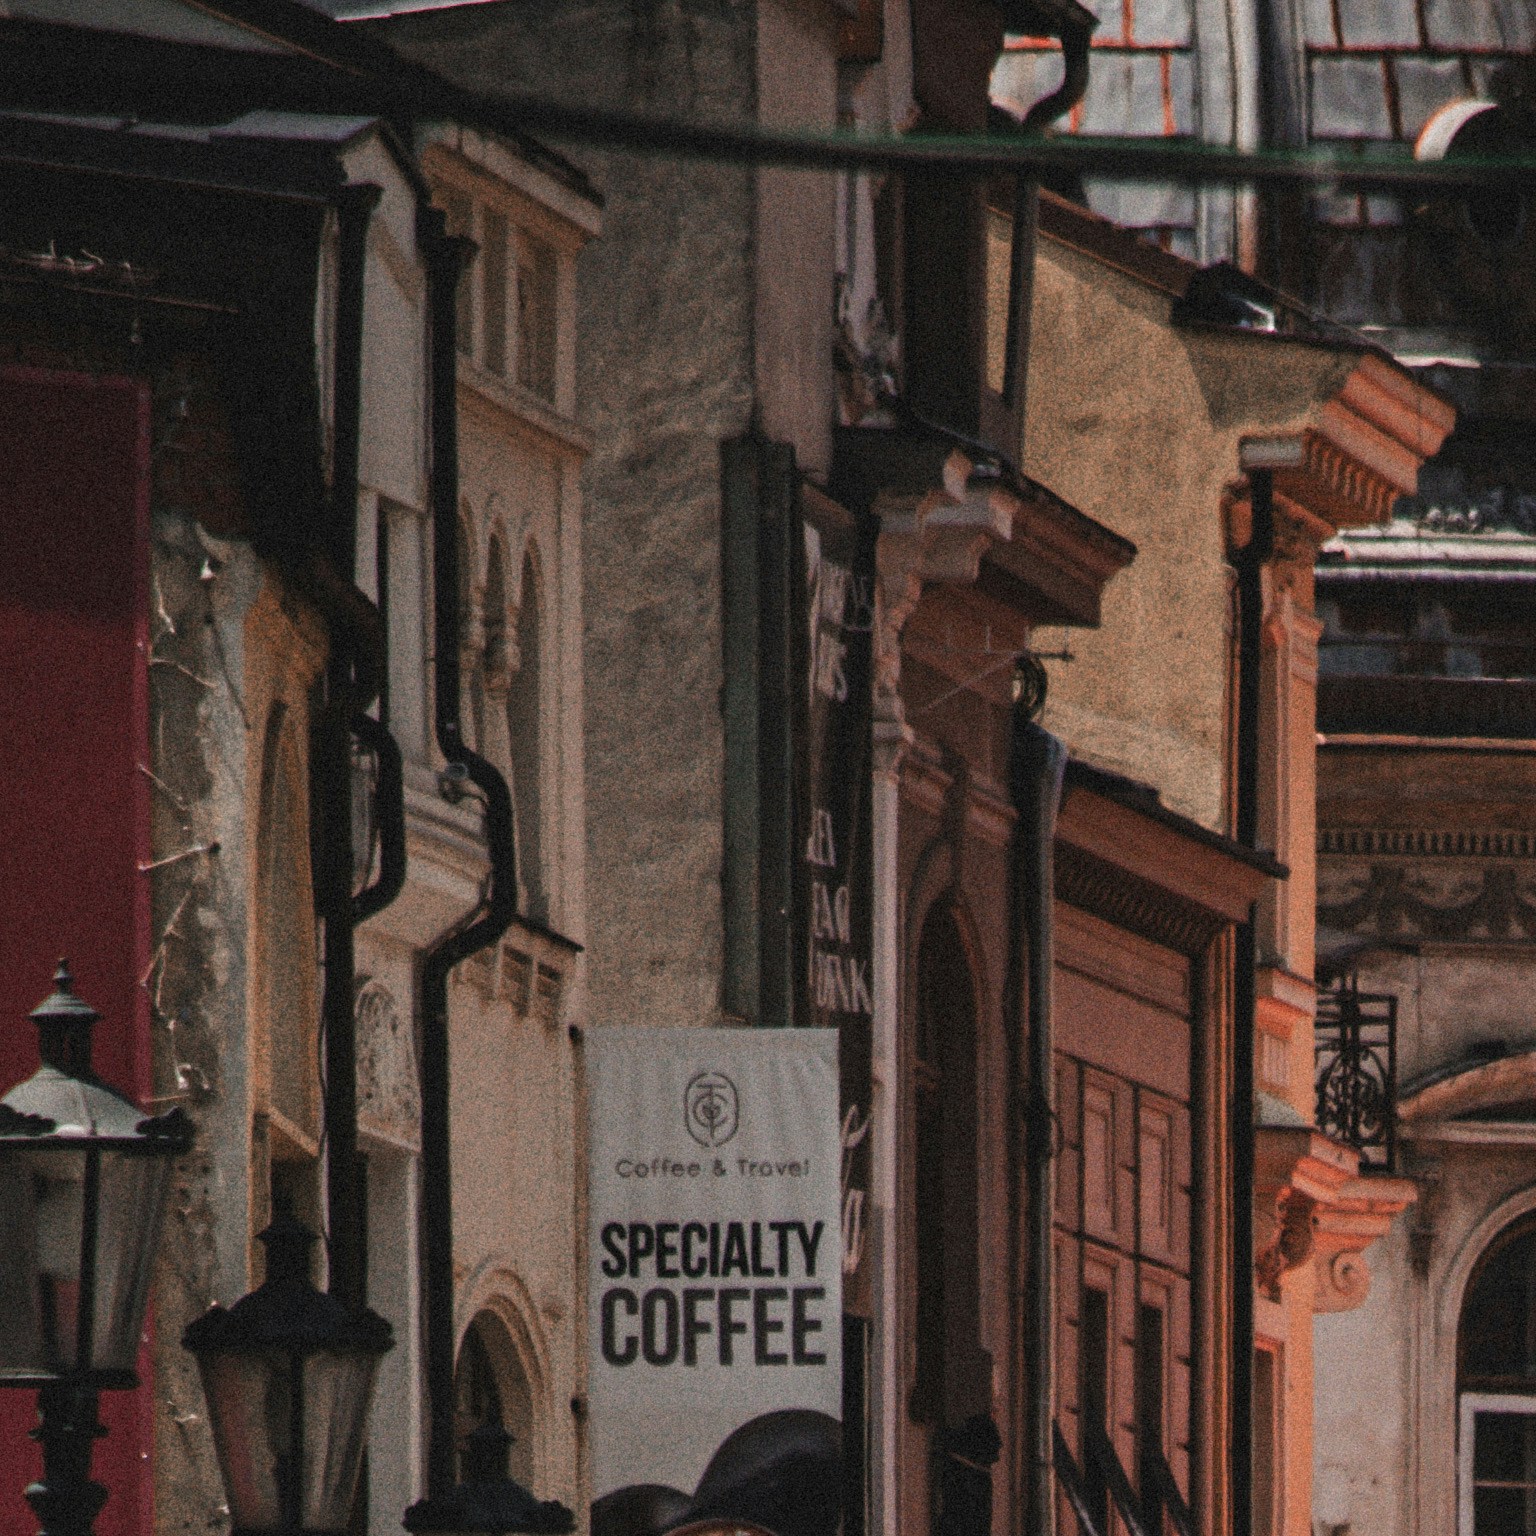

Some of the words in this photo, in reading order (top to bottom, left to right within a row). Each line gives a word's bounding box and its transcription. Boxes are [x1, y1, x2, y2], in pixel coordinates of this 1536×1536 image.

[614, 1158, 701, 1179] Coffee
[713, 1159, 726, 1177] &
[736, 1158, 809, 1177] Travel
[600, 1221, 824, 1279] SPECIALTY
[600, 1287, 827, 1367] COFFEE
